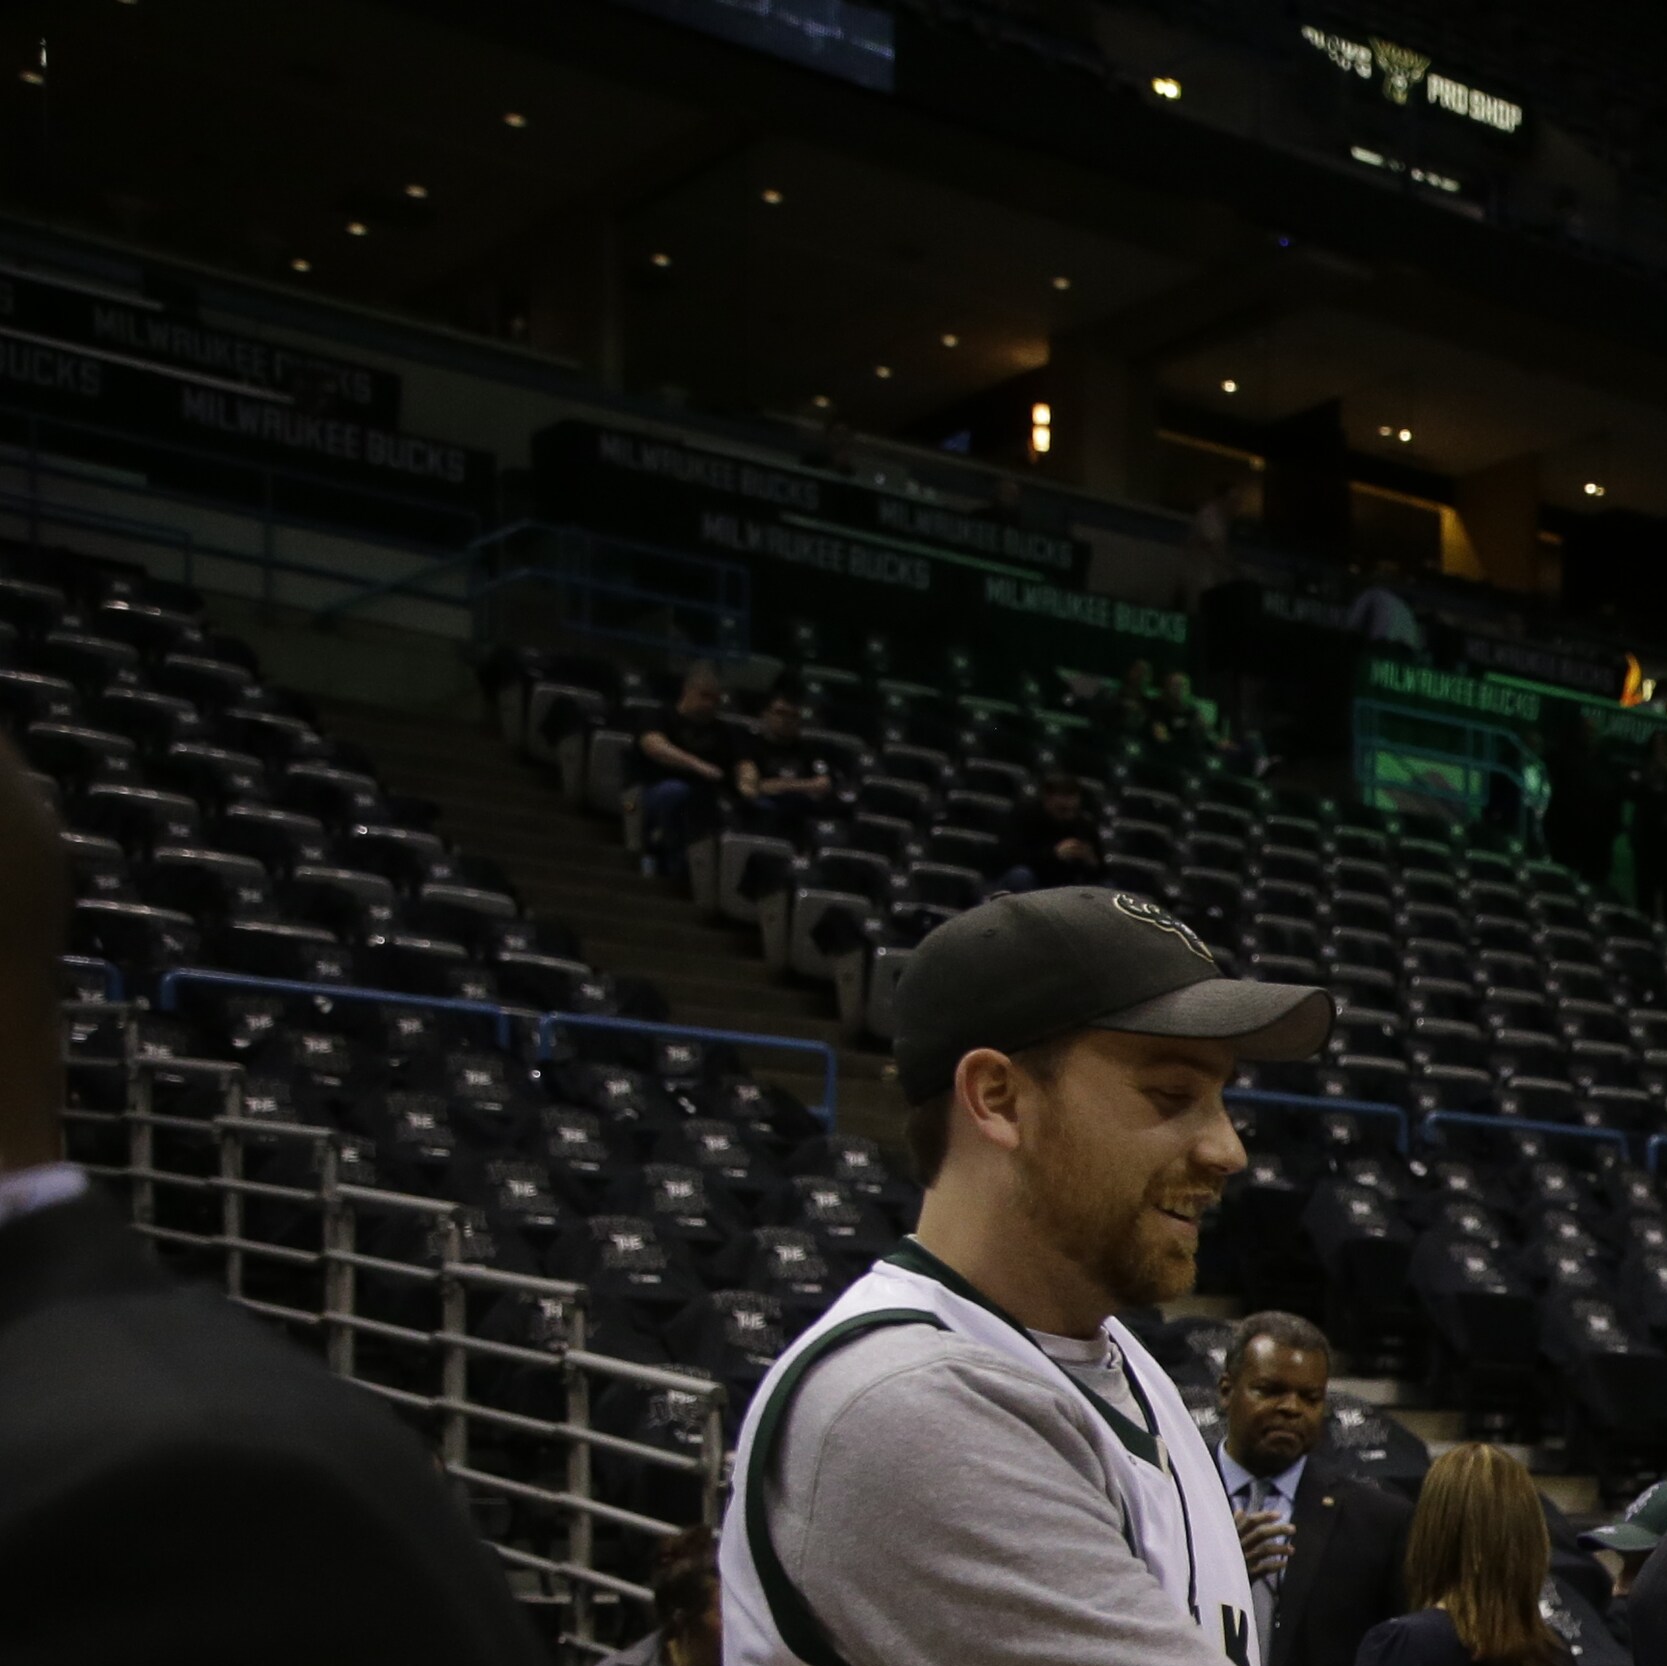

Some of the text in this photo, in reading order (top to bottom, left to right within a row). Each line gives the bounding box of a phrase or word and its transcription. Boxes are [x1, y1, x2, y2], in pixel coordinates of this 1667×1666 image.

[1469, 88, 1523, 133] SHOP
[0, 340, 100, 398] UCKS
[182, 384, 466, 483] MILWAUKEE BUCKS
[731, 1309, 768, 1330] THE
